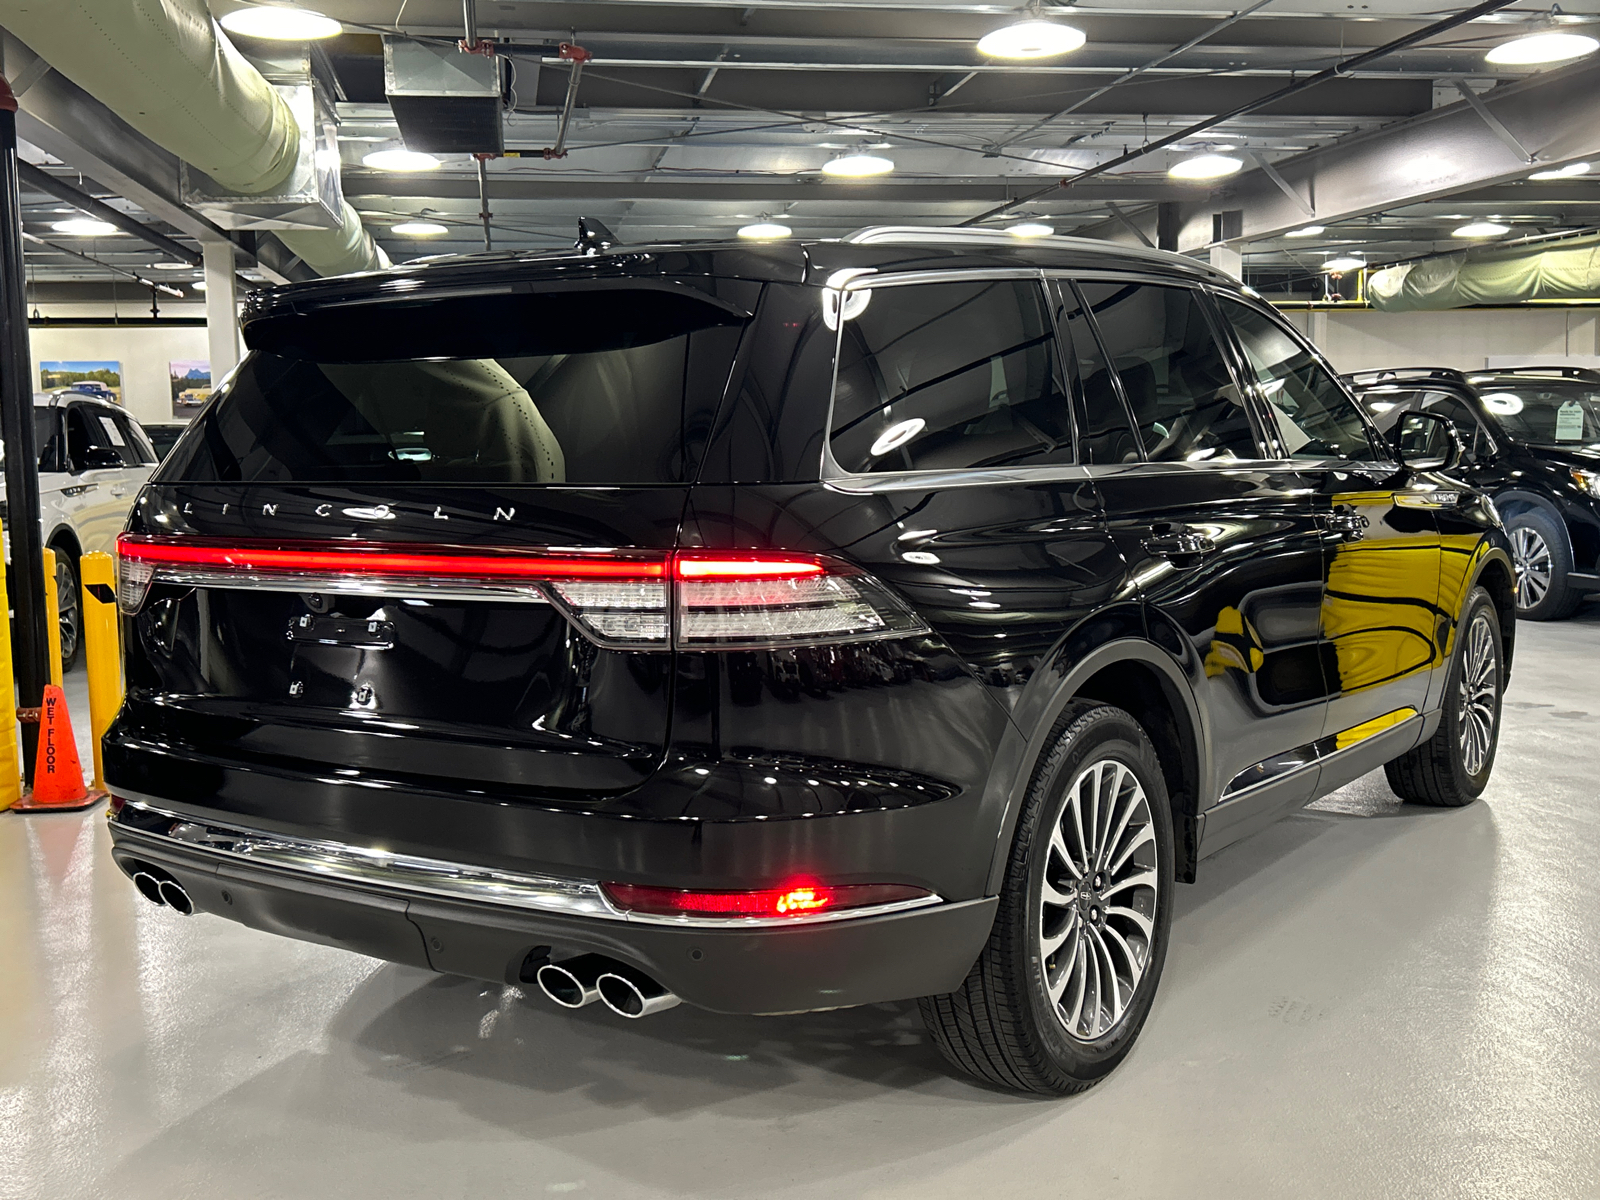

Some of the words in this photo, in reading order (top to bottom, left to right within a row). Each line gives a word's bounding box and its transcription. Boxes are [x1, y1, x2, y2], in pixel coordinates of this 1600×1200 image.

[183, 502, 516, 521] LINCOLN
[46, 697, 57, 725] WET
[46, 728, 56, 774] FLOOR
